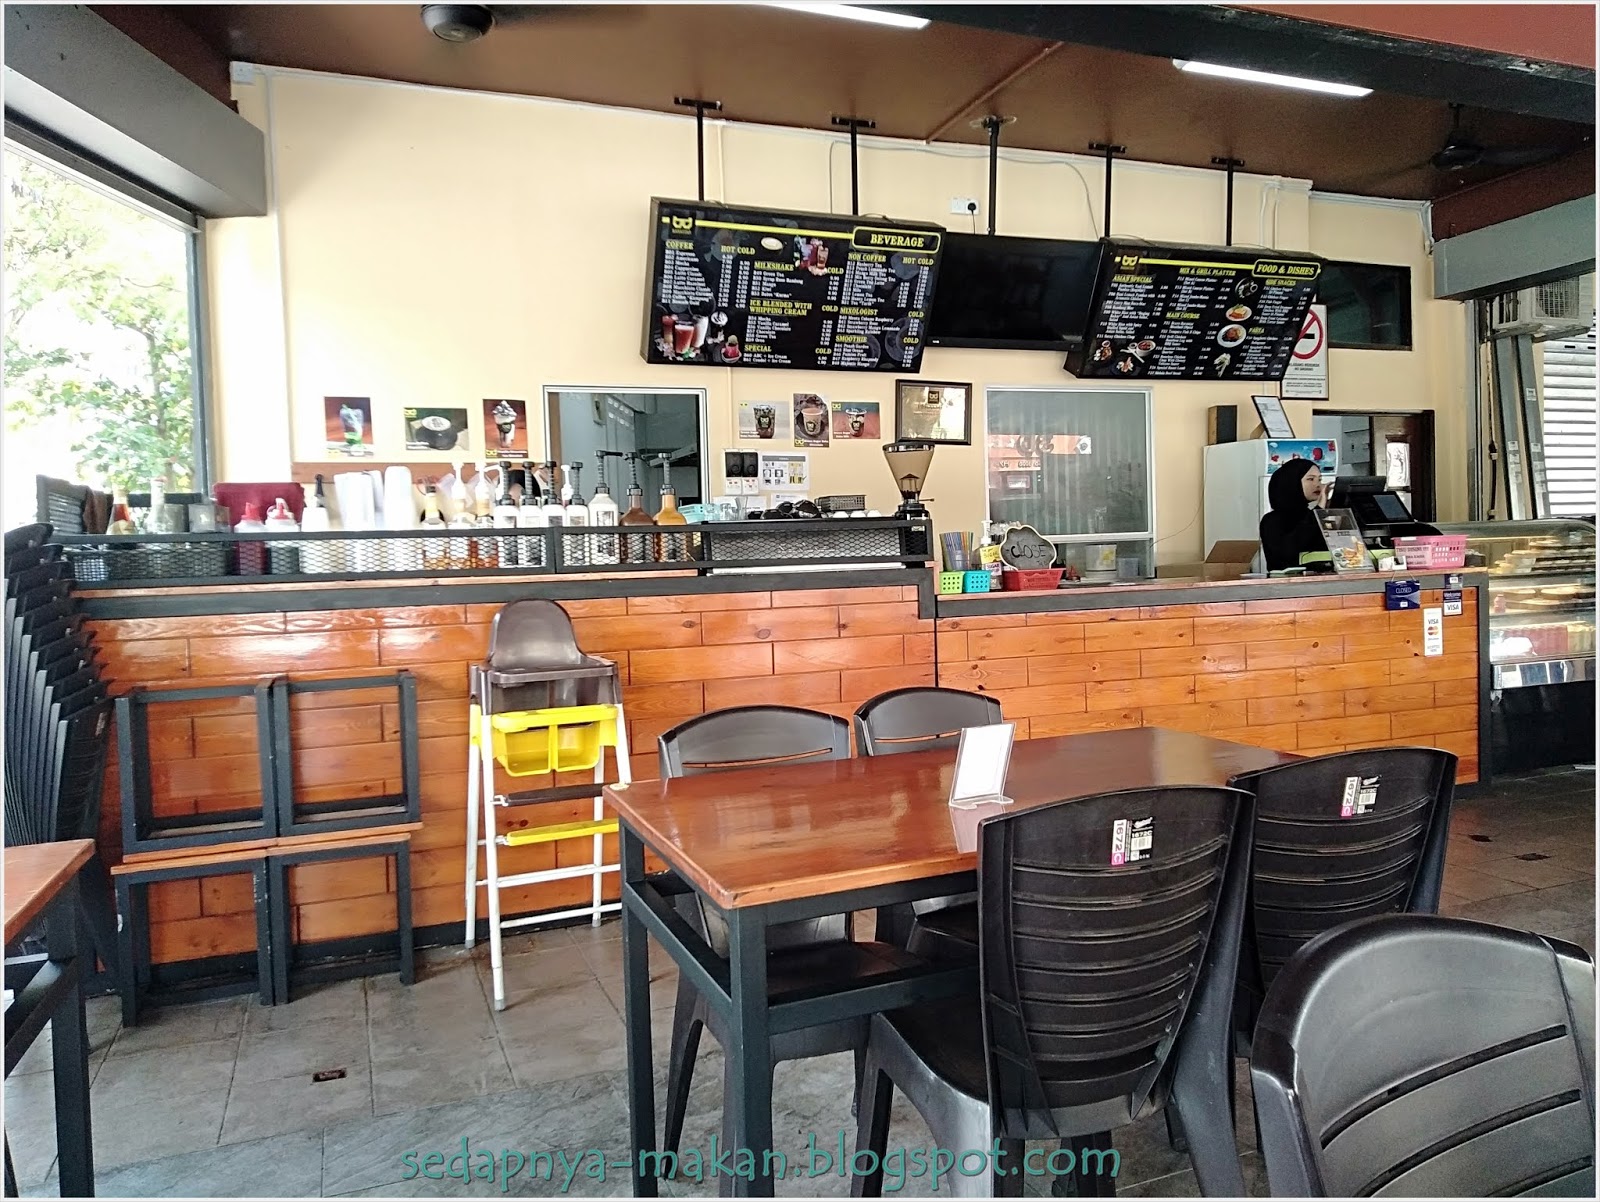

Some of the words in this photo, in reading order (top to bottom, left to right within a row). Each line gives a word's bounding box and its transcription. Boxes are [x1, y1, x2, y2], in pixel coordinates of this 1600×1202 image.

[666, 241, 694, 250] COFFEE
[870, 234, 924, 247] BEVERAGE
[754, 261, 794, 271] MILKSHAKE
[1257, 264, 1278, 274] FOOD
[1278, 266, 1285, 274] &
[1287, 266, 1314, 275] DISHES
[840, 308, 878, 316] MIXOLOGIST
[1114, 822, 1124, 863] 1672C
